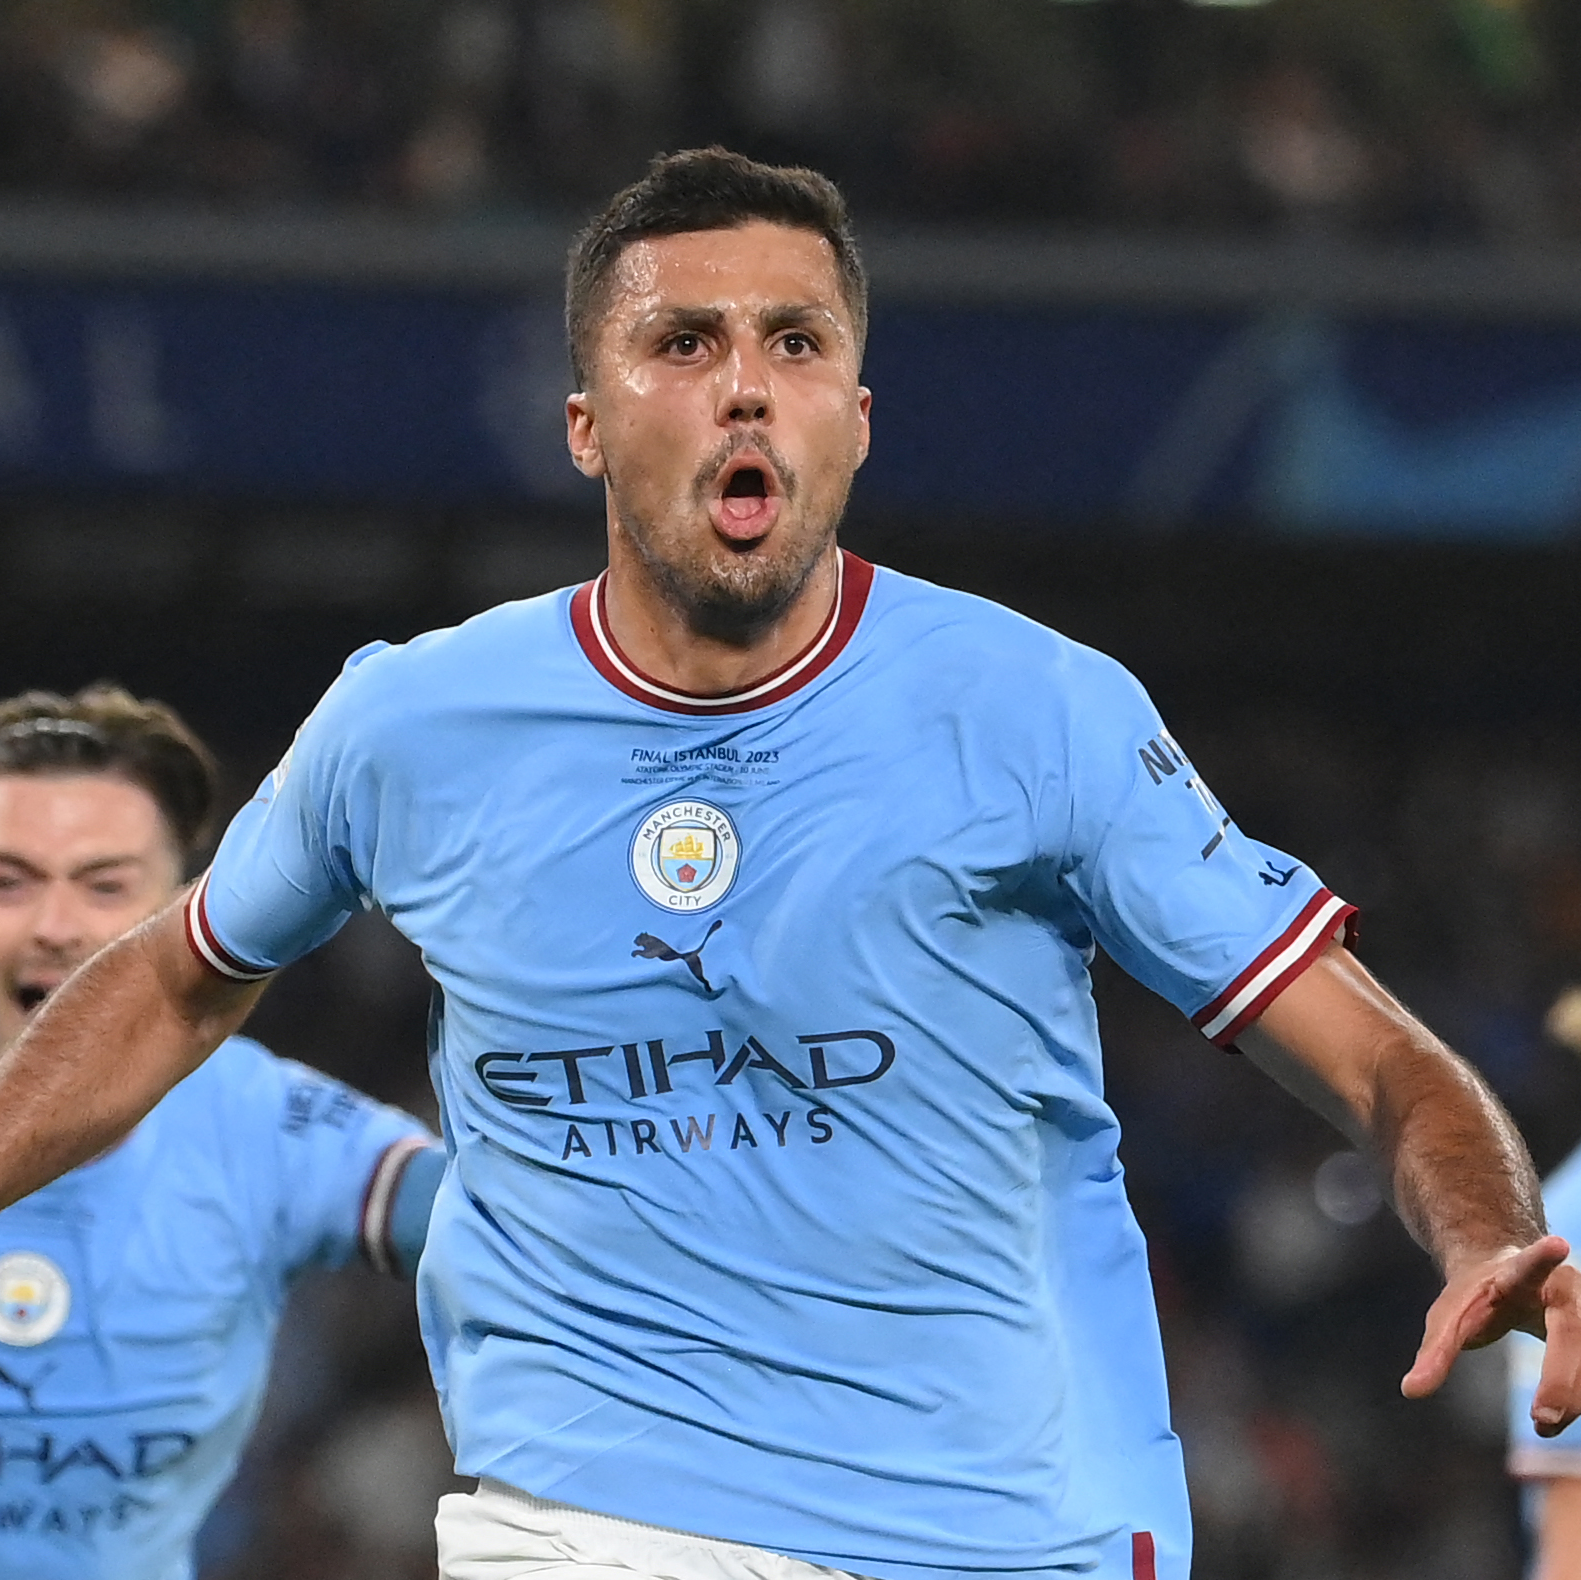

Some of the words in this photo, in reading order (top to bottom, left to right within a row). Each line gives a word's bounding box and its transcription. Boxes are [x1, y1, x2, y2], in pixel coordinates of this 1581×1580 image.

[631, 748, 671, 764] FINAL
[674, 747, 742, 763] ISTANBUL
[745, 750, 780, 764] 2023
[643, 805, 731, 842] MANCHESTER
[668, 895, 702, 906] CITY
[475, 1029, 896, 1107] ETIHAD
[562, 1107, 834, 1161] AIRWAYS
